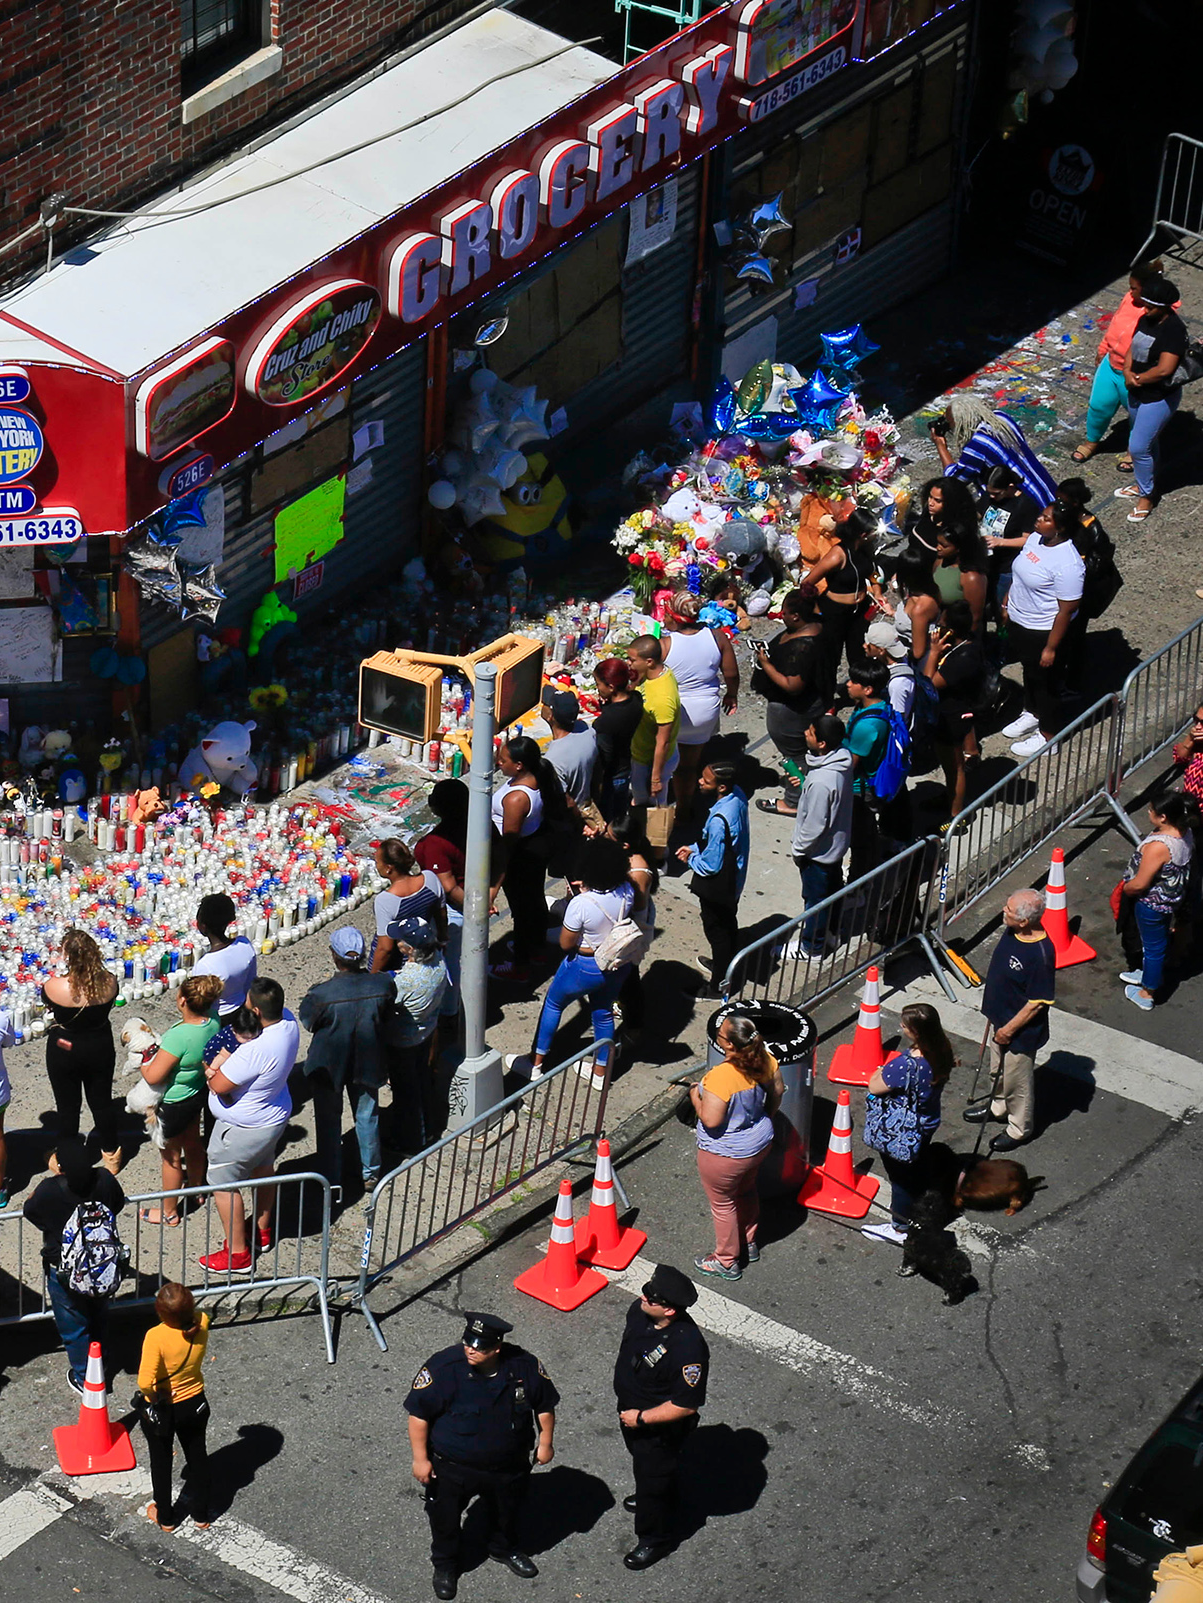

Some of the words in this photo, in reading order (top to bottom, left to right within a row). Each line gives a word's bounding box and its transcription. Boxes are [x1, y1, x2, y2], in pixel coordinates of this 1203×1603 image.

[754, 49, 843, 119] 718-561-6343
[390, 44, 733, 323] GROCERY
[1029, 189, 1086, 229] OPEN
[264, 344, 299, 381] Cruz
[298, 321, 331, 360] and
[329, 298, 374, 341] Chiky
[281, 354, 333, 398] Store
[178, 461, 205, 492] 526E
